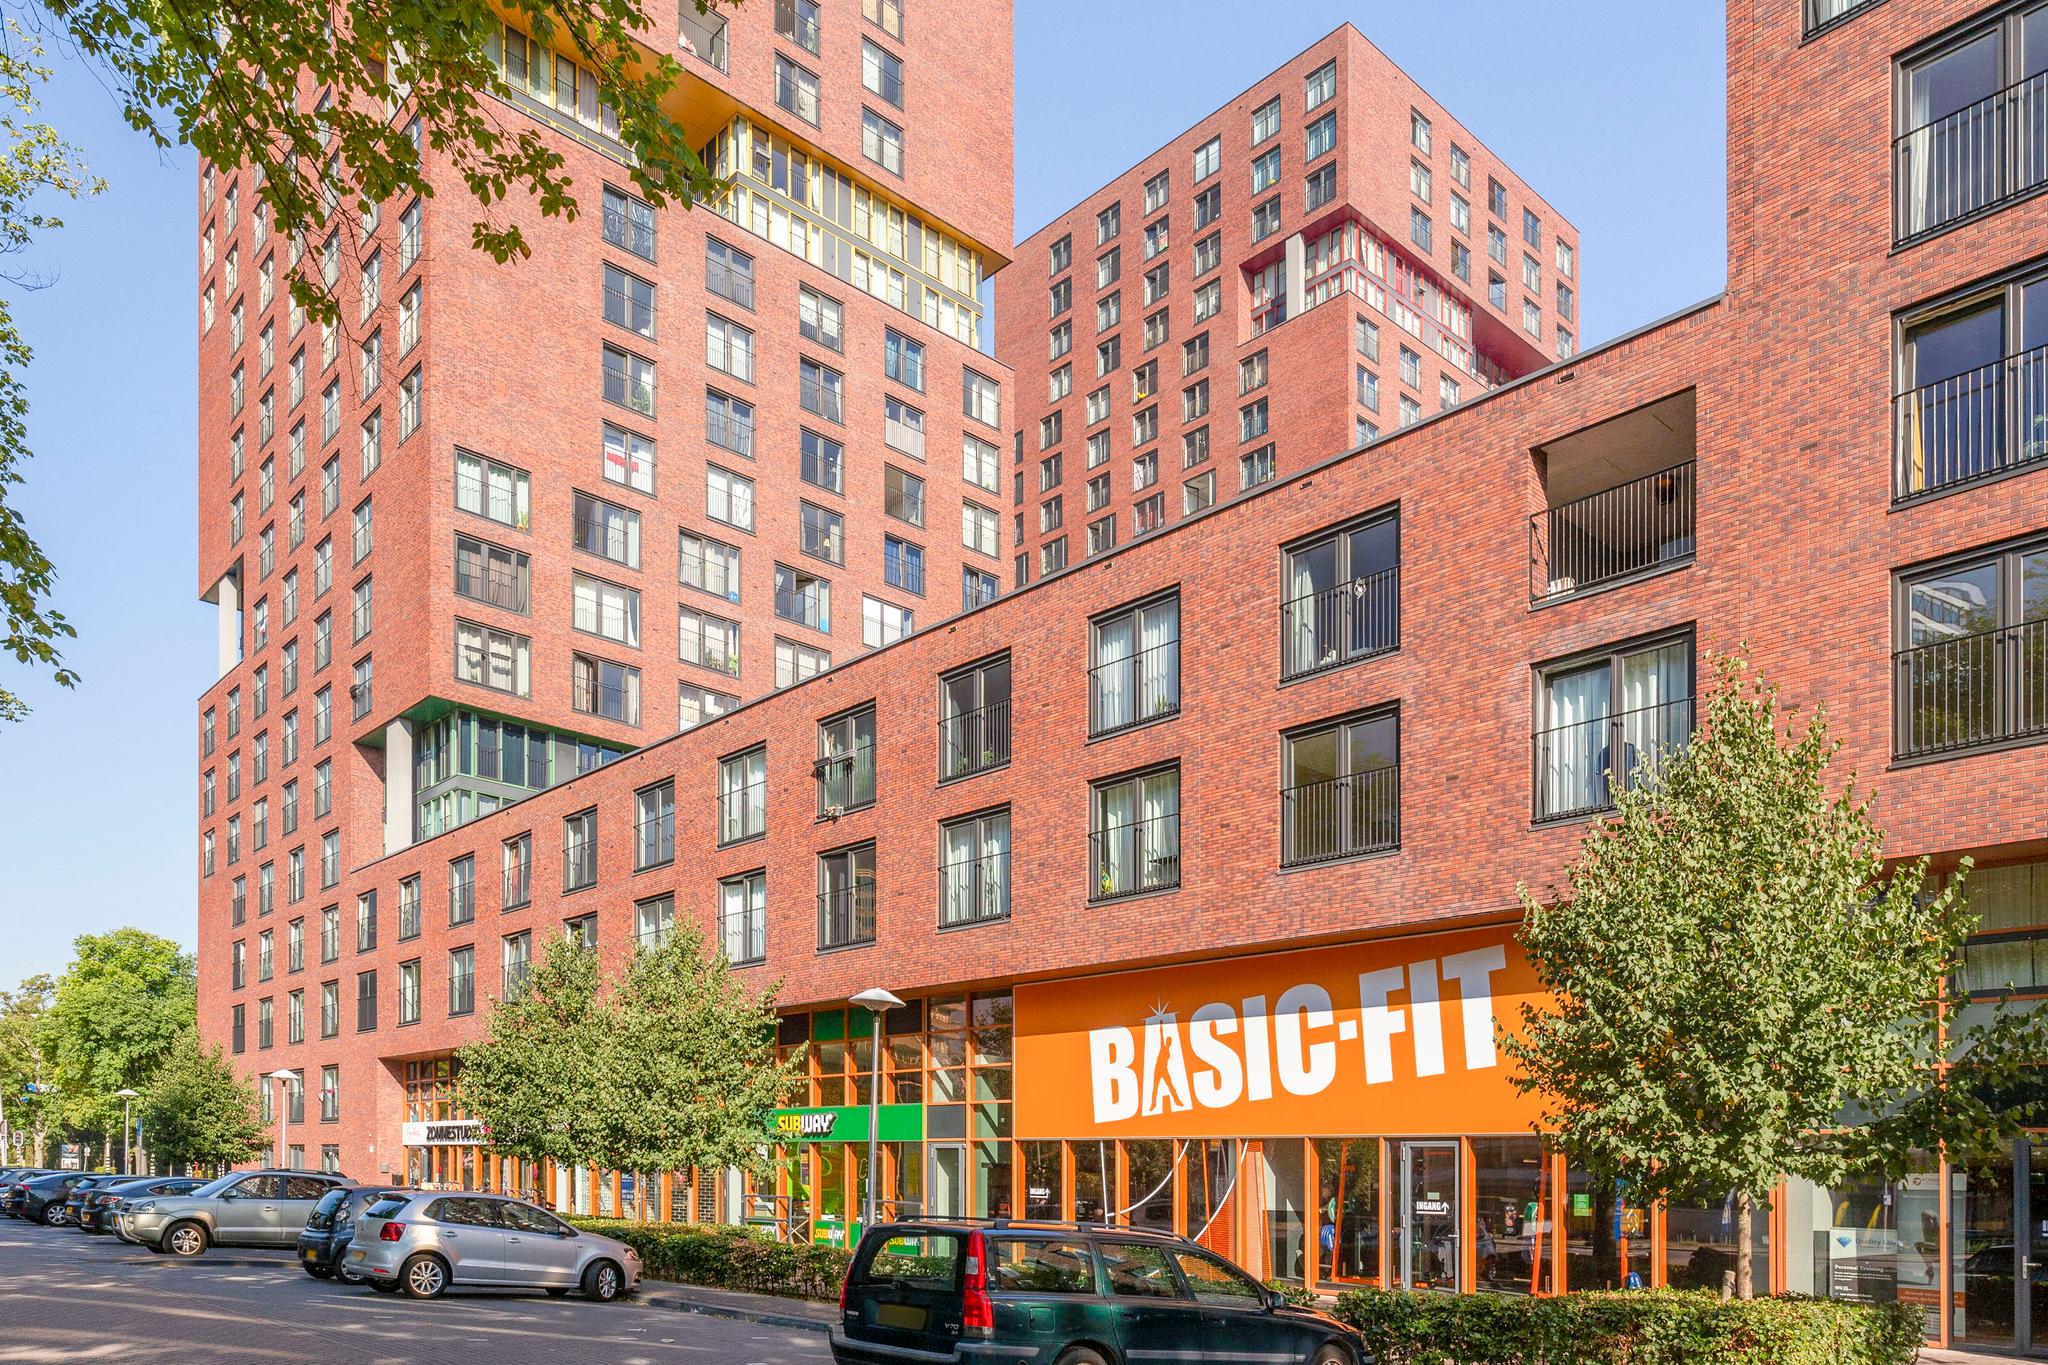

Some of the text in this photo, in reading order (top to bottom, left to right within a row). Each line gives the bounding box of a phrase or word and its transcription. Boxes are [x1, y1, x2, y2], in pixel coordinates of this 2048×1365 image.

[1089, 943, 1506, 1124] BASIC-FIT
[777, 1112, 833, 1133] SUBWAY
[1416, 1201, 1441, 1211] INGANG
[944, 1322, 960, 1330] V70
